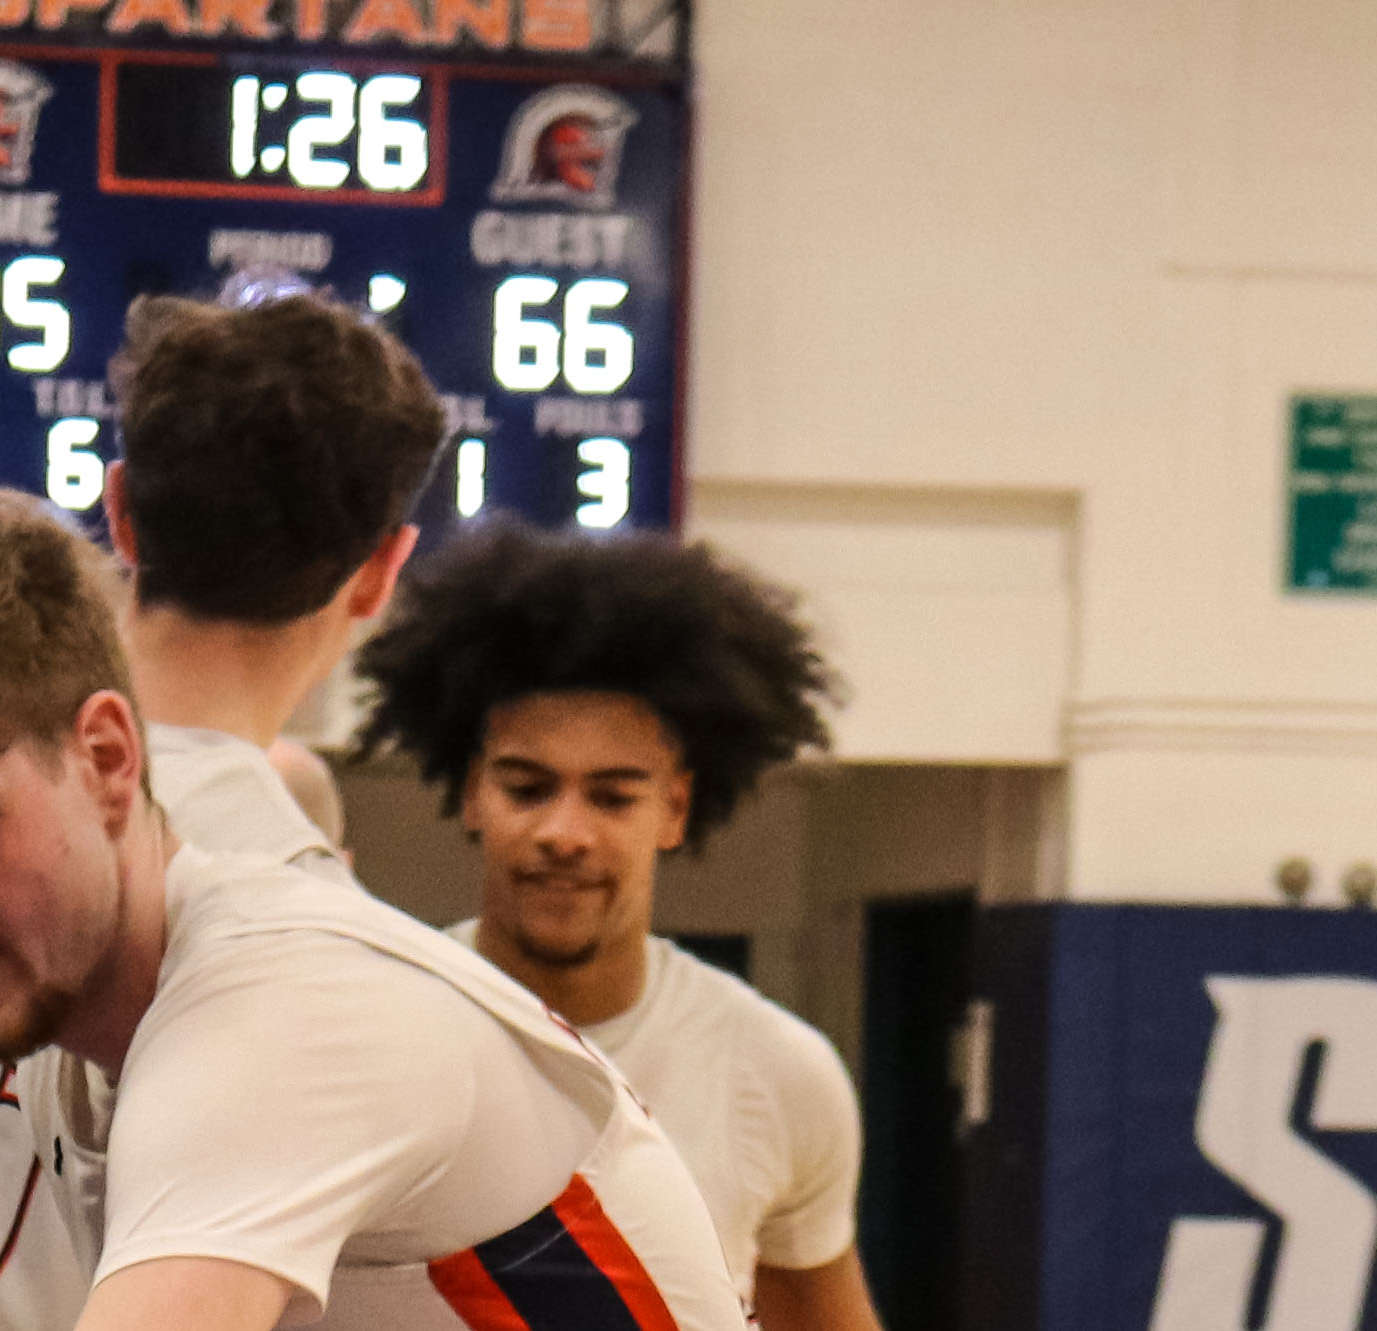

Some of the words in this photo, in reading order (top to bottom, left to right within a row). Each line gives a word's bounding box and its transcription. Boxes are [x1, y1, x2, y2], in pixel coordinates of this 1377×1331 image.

[229, 70, 429, 192] 1:26
[470, 210, 637, 268] GUEST
[492, 273, 635, 395] 66
[46, 417, 105, 511] 6
[456, 437, 487, 518] 1
[575, 436, 631, 529] 3
